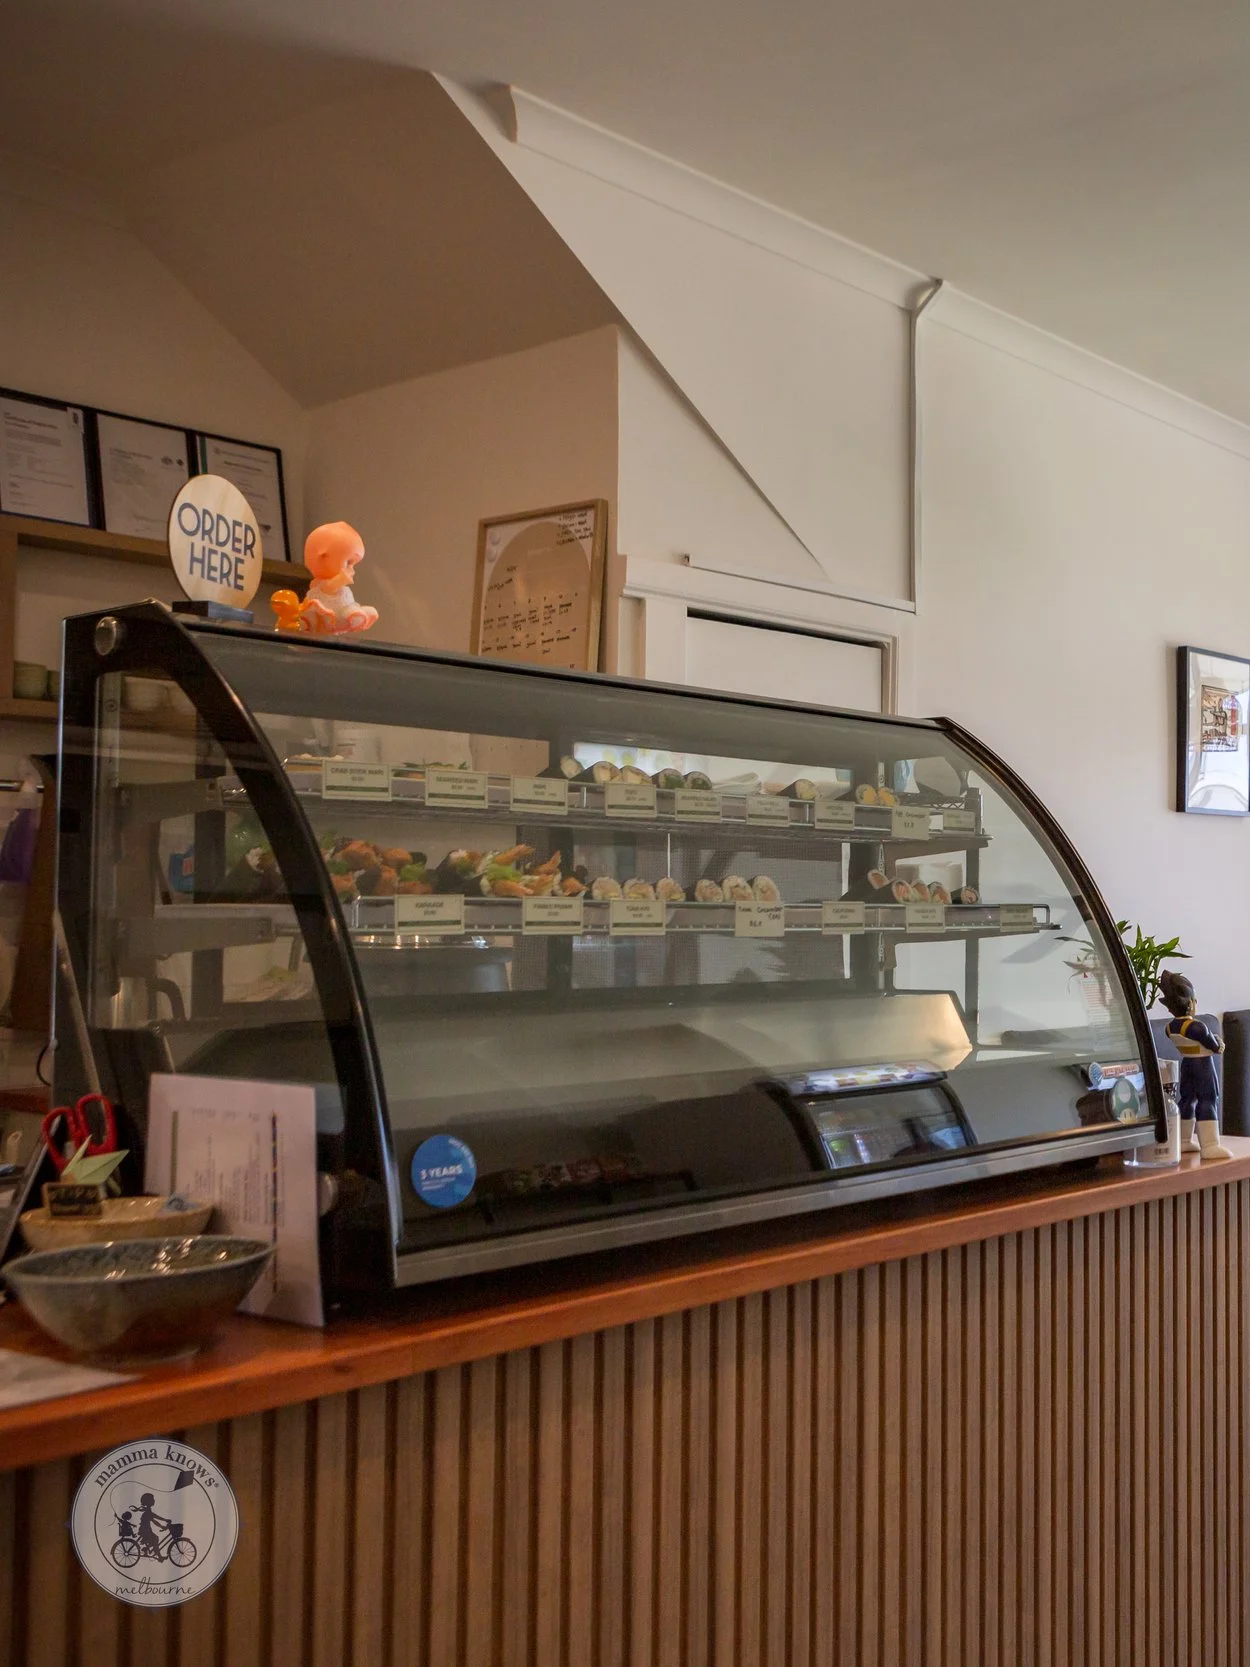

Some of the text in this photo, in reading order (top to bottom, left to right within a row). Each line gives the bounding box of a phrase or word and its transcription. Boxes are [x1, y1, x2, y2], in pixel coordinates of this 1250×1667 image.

[177, 502, 256, 559] ORDER
[189, 541, 245, 591] HERE
[428, 1164, 463, 1178] YEARS
